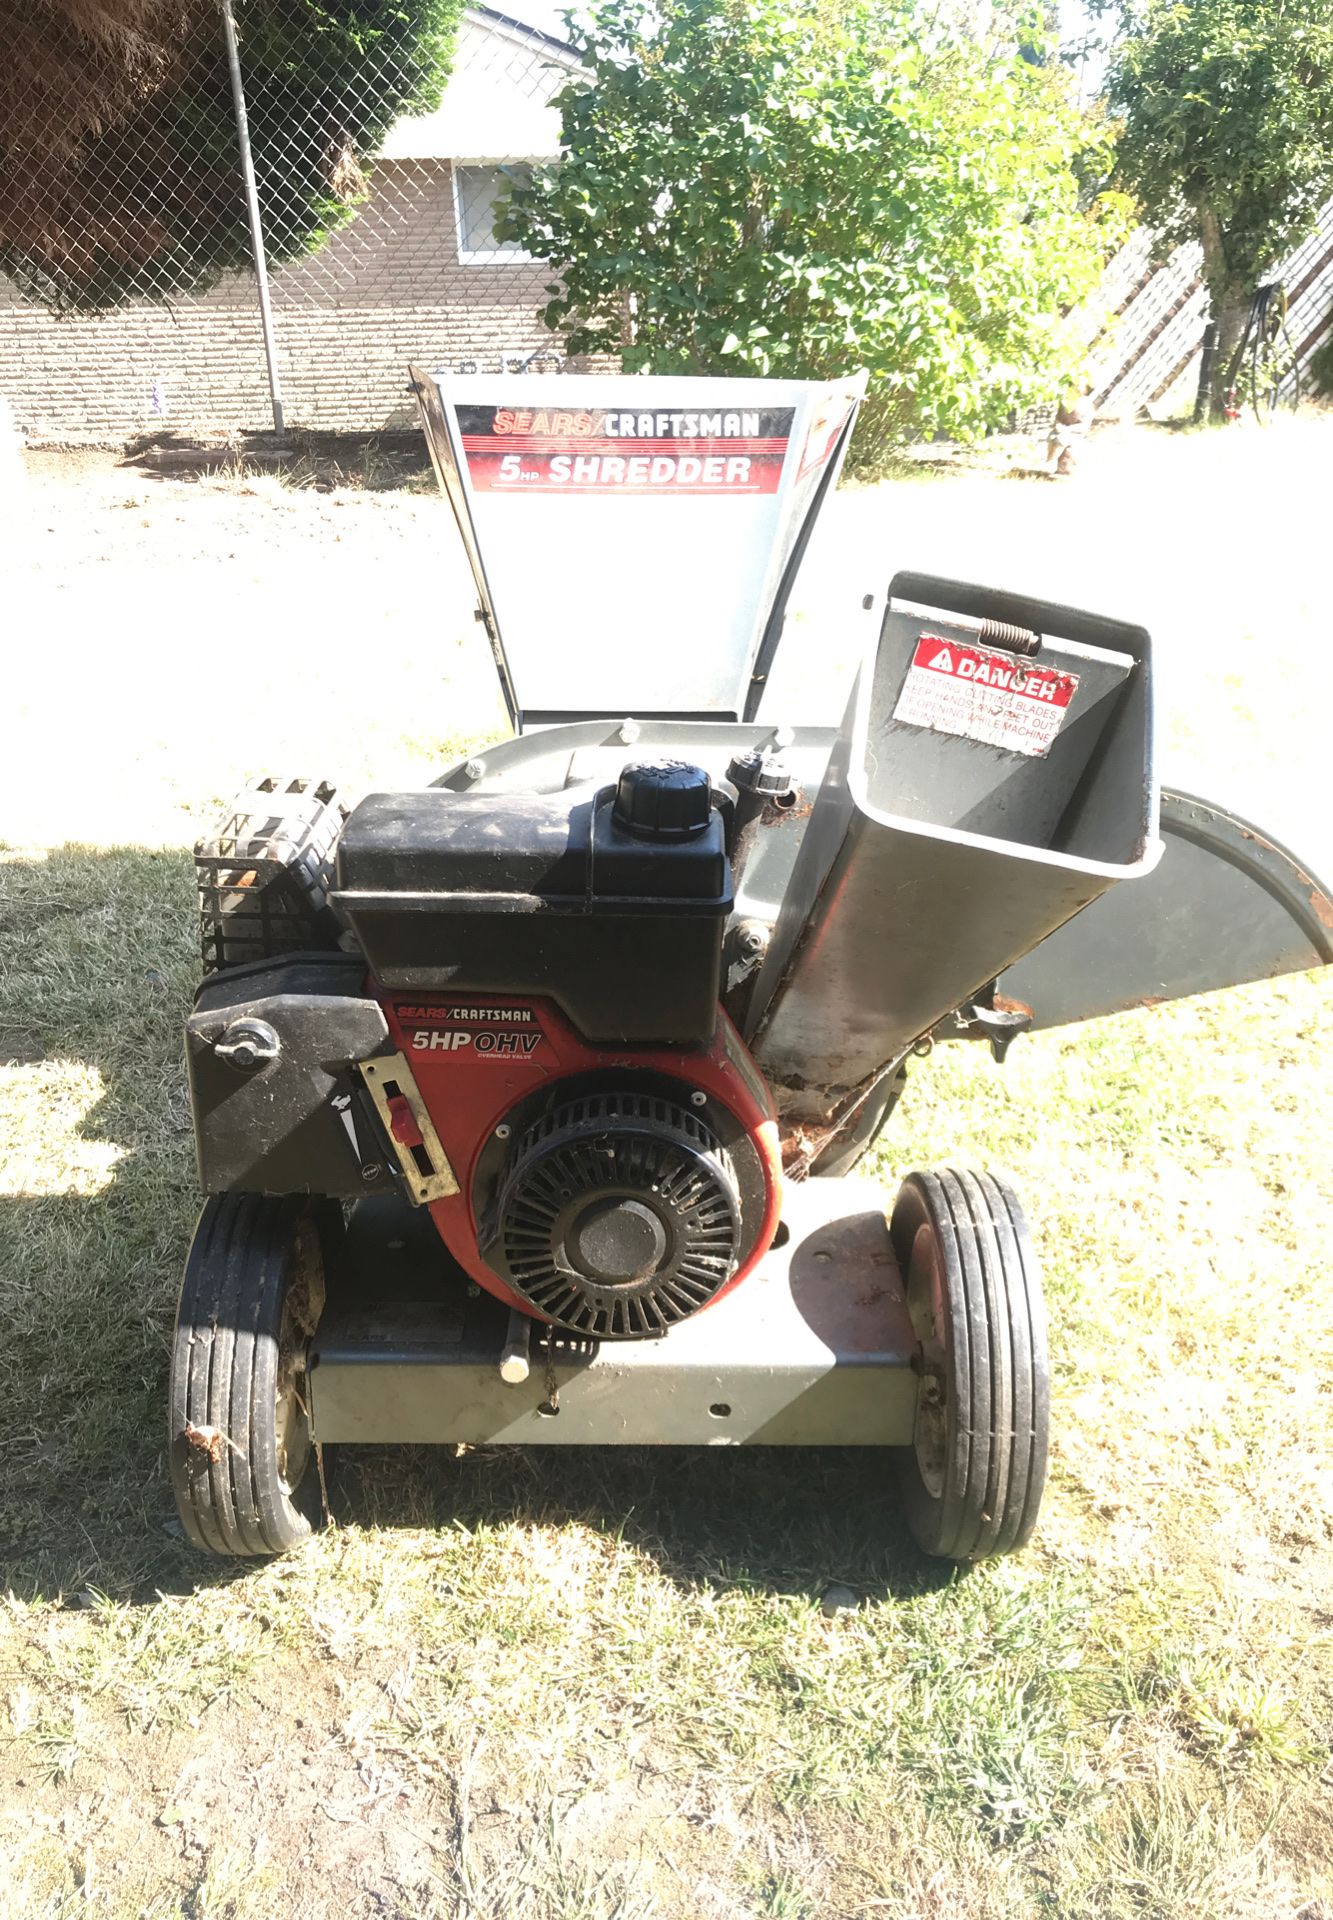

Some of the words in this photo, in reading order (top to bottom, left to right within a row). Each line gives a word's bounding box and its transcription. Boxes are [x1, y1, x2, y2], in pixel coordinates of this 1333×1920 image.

[549, 456, 751, 483] SHREDDER
[957, 658, 1057, 700] DANGER
[964, 687, 1013, 708] CUTTING
[1015, 701, 1057, 720] BLADES
[916, 698, 965, 719] OPENING
[1002, 722, 1050, 743] MACHINE
[1031, 718, 1055, 732] OUT
[412, 1031, 471, 1050] 5HP
[473, 1032, 541, 1054] OHV
